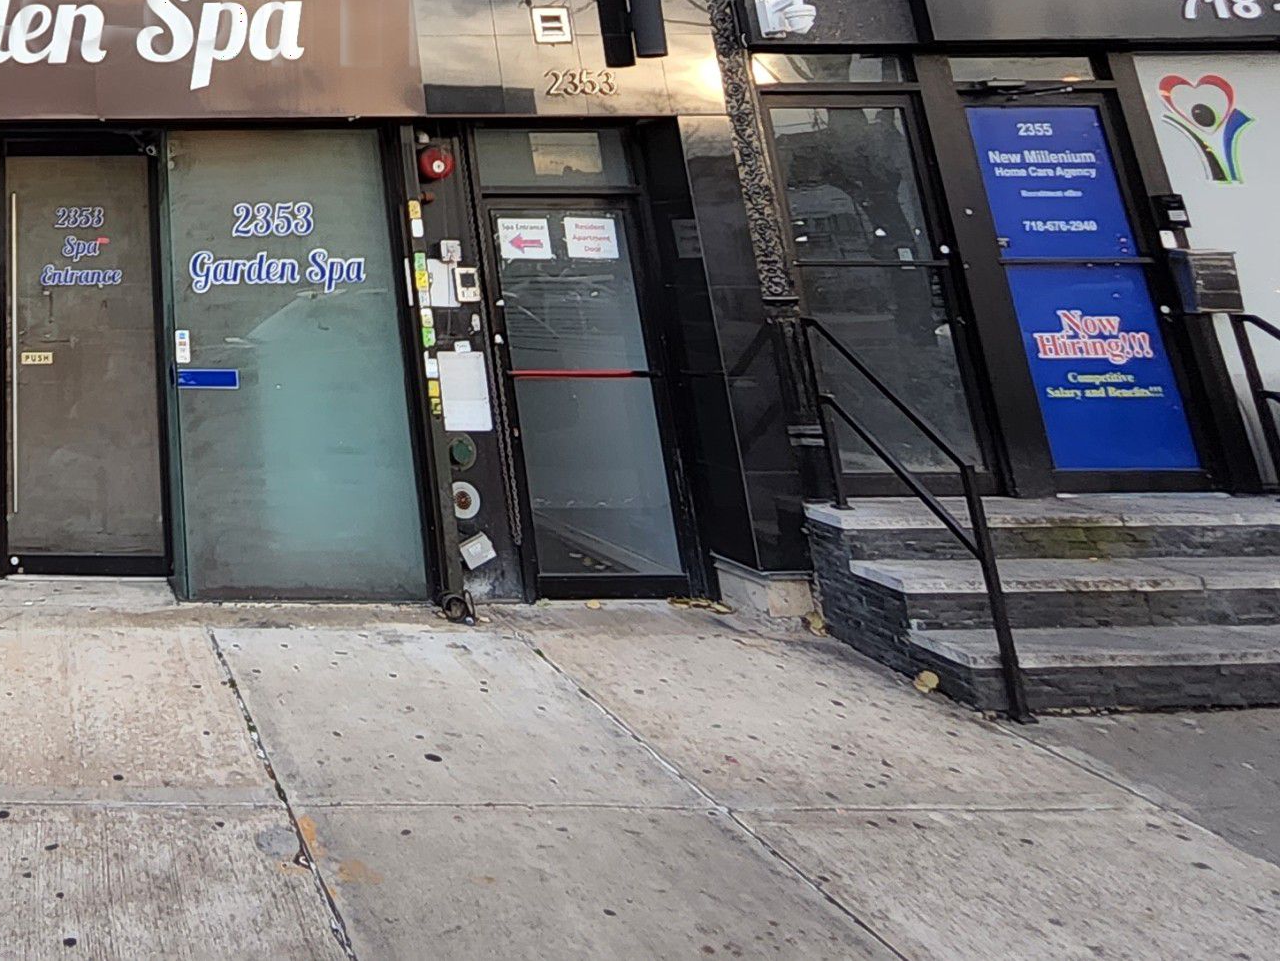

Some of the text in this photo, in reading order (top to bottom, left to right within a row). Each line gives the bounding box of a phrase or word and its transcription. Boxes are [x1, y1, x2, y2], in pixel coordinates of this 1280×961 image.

[543, 70, 617, 97] 2353
[1016, 123, 1053, 136] 2355
[987, 150, 1021, 164] New
[994, 166, 1097, 179] Home Care Agency
[53, 206, 105, 229] 2353
[231, 201, 315, 237] 2353
[61, 235, 101, 262] Spa
[40, 263, 123, 286] Entrance
[188, 248, 367, 294] Garden Spa
[1056, 309, 1121, 336] Now
[24, 354, 50, 362] PUSH
[1033, 331, 1154, 365] Hiring!!!
